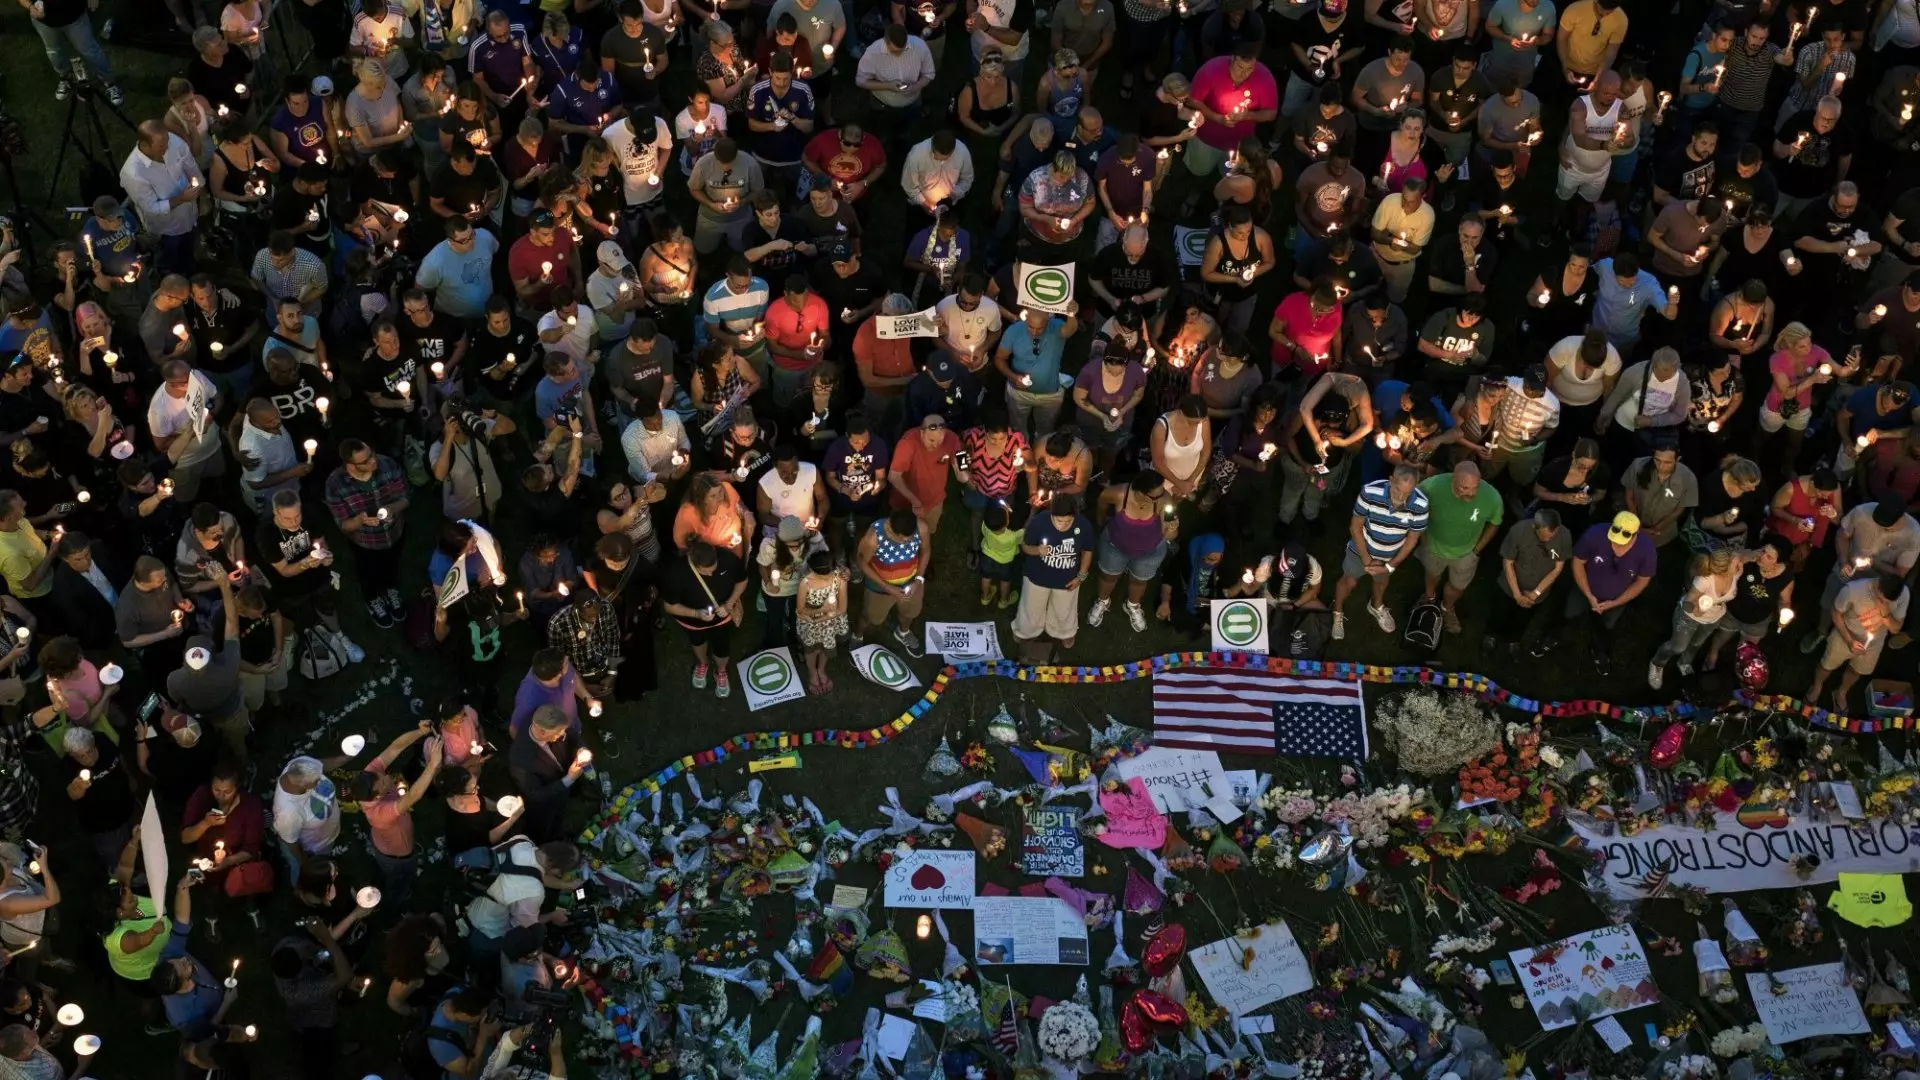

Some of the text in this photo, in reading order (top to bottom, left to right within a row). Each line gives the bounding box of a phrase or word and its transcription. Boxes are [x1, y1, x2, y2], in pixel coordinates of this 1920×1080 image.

[1111, 267, 1151, 279] PLEASE
[894, 318, 920, 326] LOVE
[894, 325, 920, 333] HATE
[943, 630, 970, 639] HATE
[943, 639, 970, 648] LOVE
[1024, 809, 1077, 828] LIGHT
[897, 893, 917, 904] our
[937, 885, 971, 907] Always
[1589, 924, 1632, 940] Sorry
